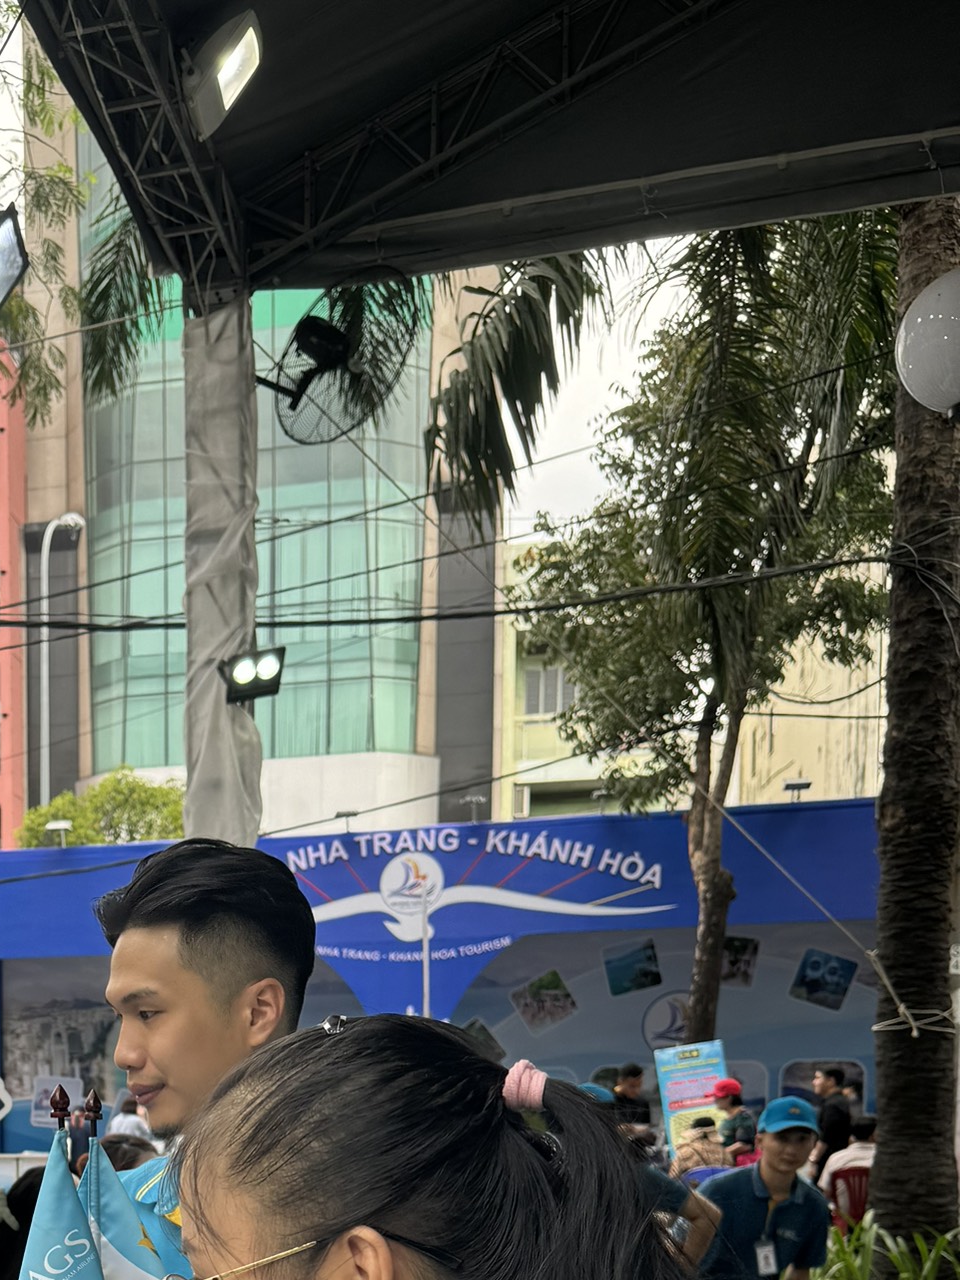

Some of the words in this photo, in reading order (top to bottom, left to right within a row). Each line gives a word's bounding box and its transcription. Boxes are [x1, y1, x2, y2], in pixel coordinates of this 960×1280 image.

[287, 843, 347, 871] NHA
[354, 828, 459, 857] TRANG
[486, 829, 594, 868] KHÁNH
[598, 849, 662, 889] HÒA
[459, 936, 512, 957] TOURISM
[77, 1253, 96, 1272] AIRLINE
